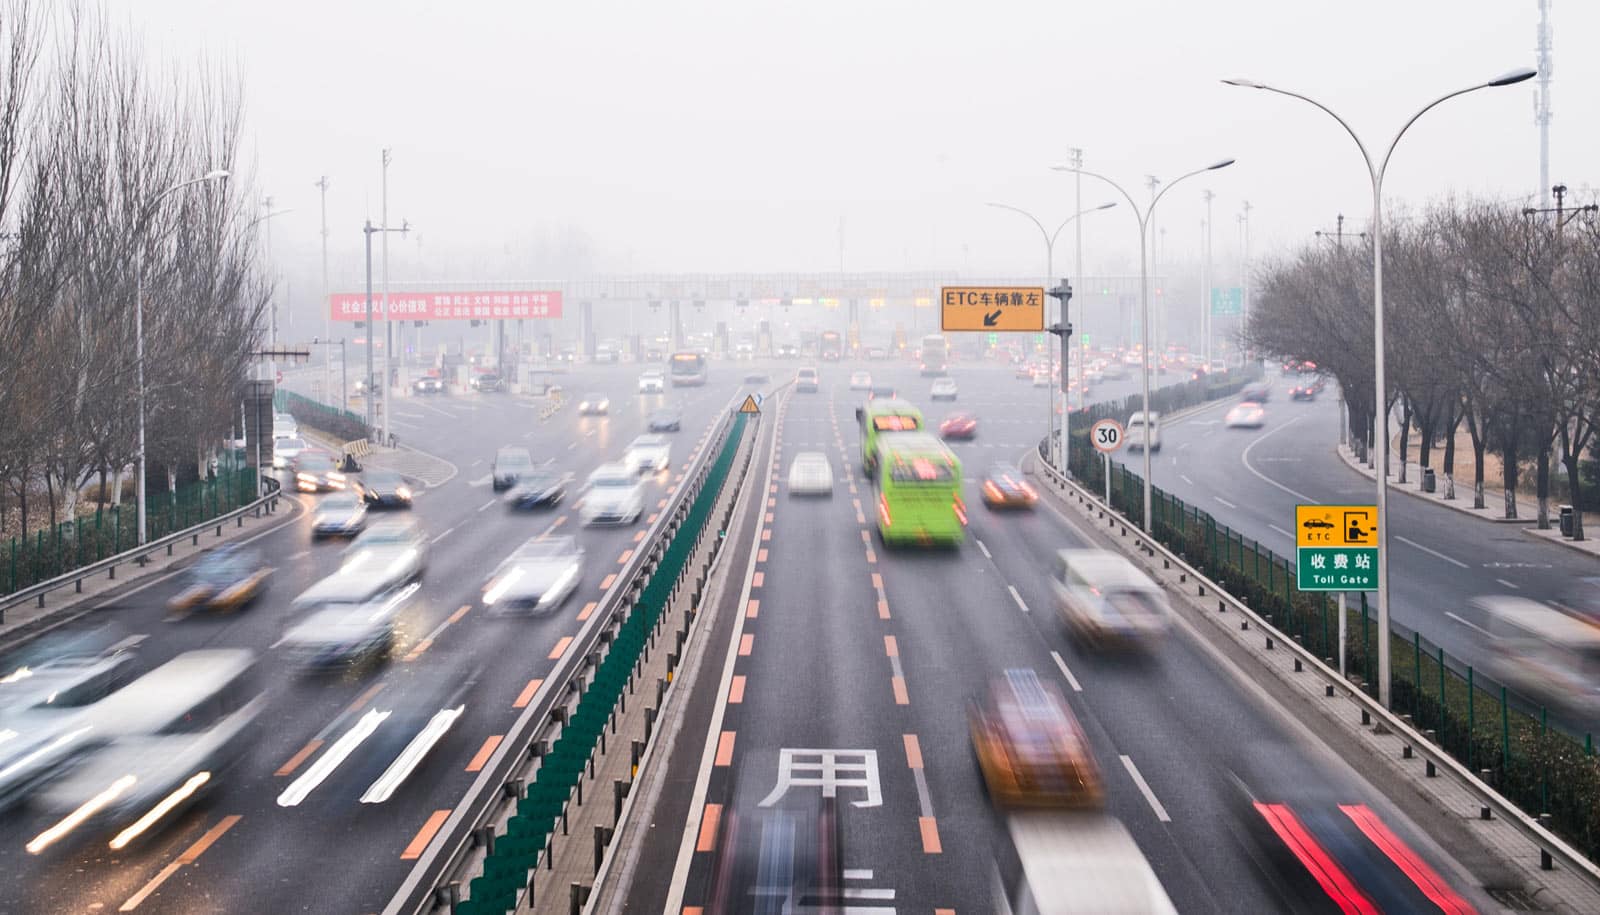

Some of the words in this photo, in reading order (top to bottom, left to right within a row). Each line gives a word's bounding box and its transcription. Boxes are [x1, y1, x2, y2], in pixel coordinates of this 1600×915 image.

[945, 291, 1041, 306] ETC车辆靠左
[1098, 428, 1117, 444] 30
[1307, 533, 1330, 541] ETC
[1311, 553, 1370, 569] 收费站
[1313, 575, 1334, 584] Toll
[1340, 575, 1369, 584] Gate
[757, 748, 883, 808] 用
